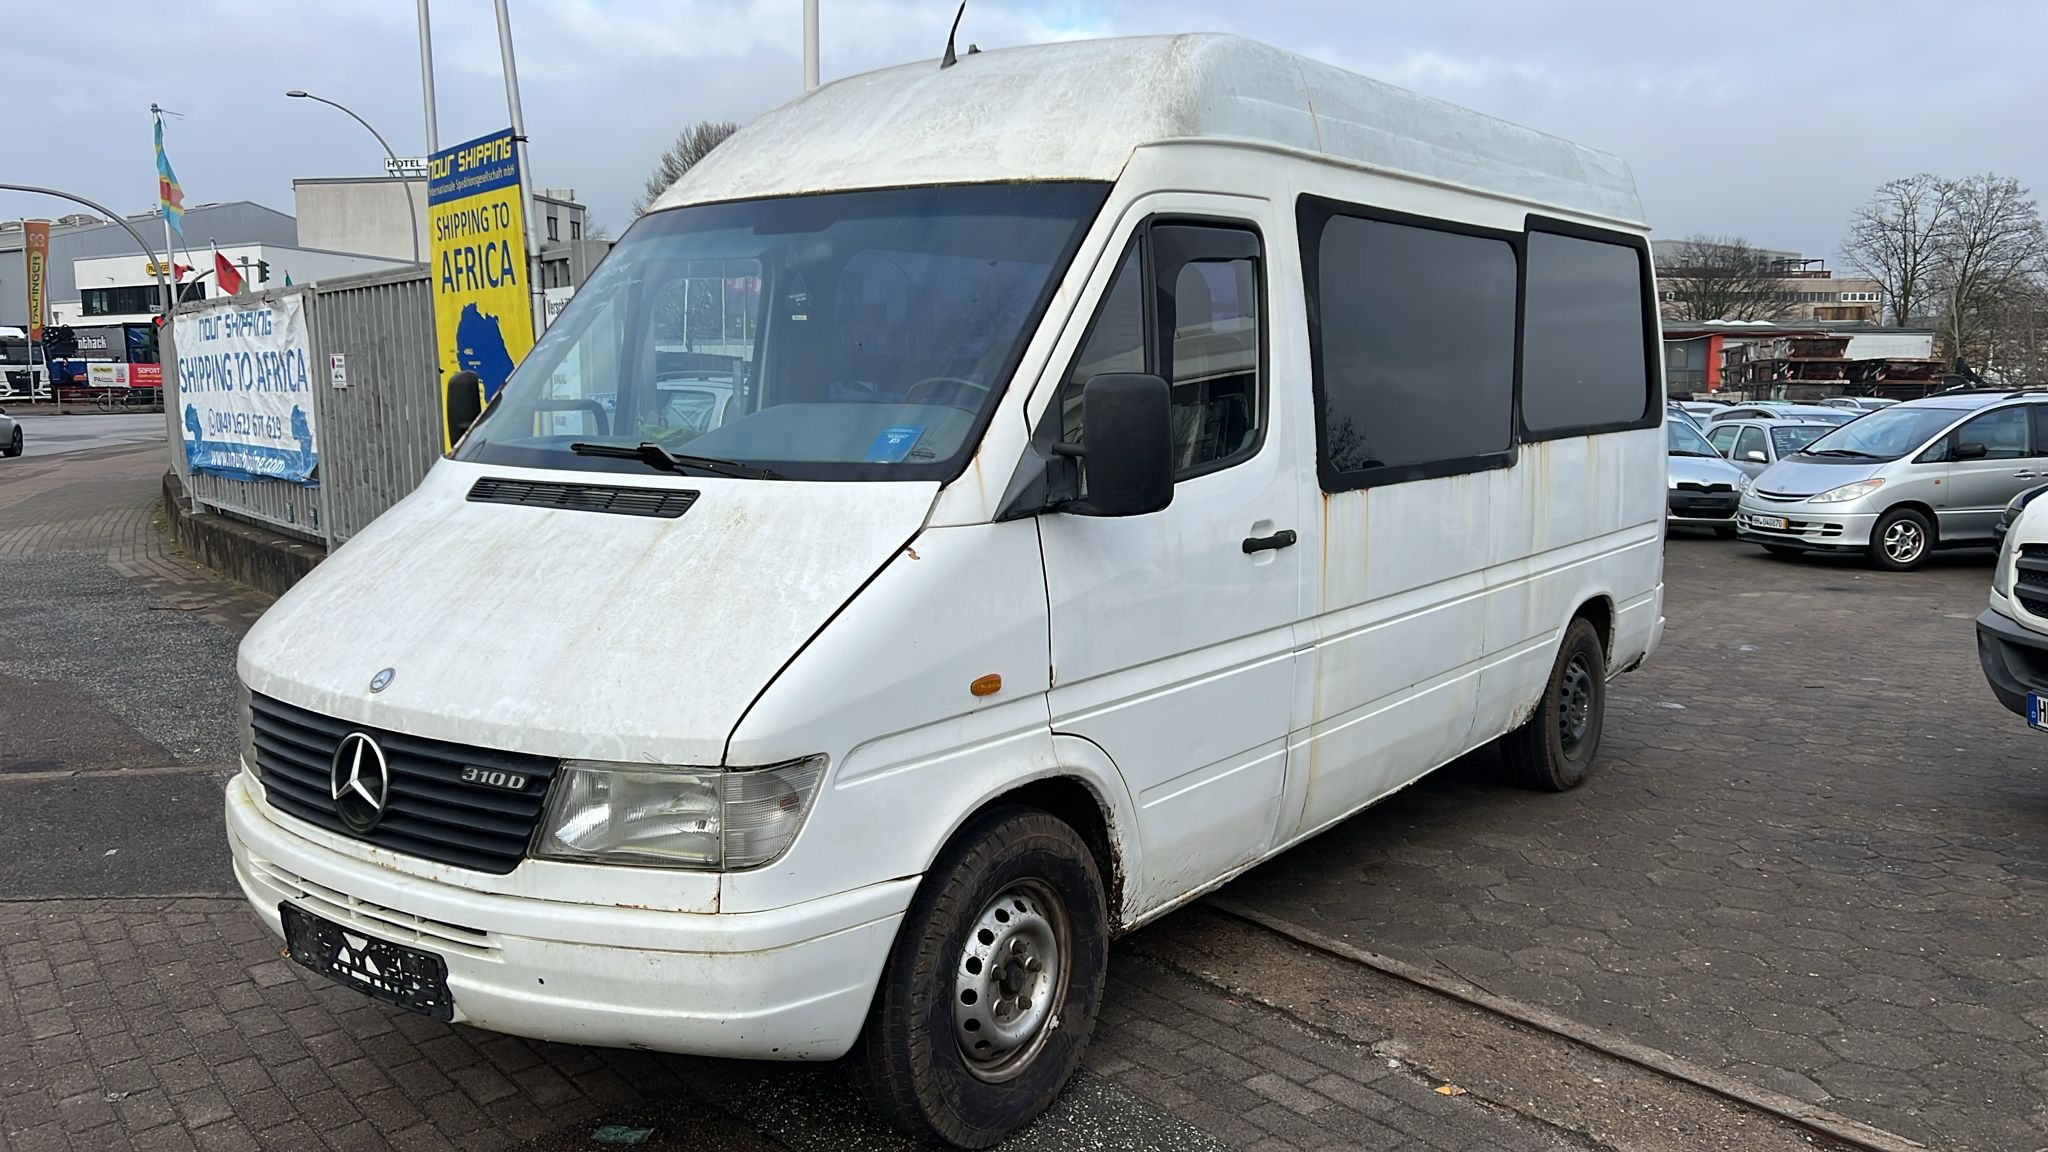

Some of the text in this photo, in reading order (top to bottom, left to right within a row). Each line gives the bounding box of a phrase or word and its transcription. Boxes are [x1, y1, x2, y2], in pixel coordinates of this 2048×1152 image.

[387, 160, 422, 168] HOTEL
[458, 136, 512, 172] SHIPPING
[436, 201, 510, 242] SHIPPING TO
[442, 239, 516, 294] AFRICA
[225, 310, 272, 338] SHIPPING
[179, 348, 309, 394] SHIPPING TO AFRICA
